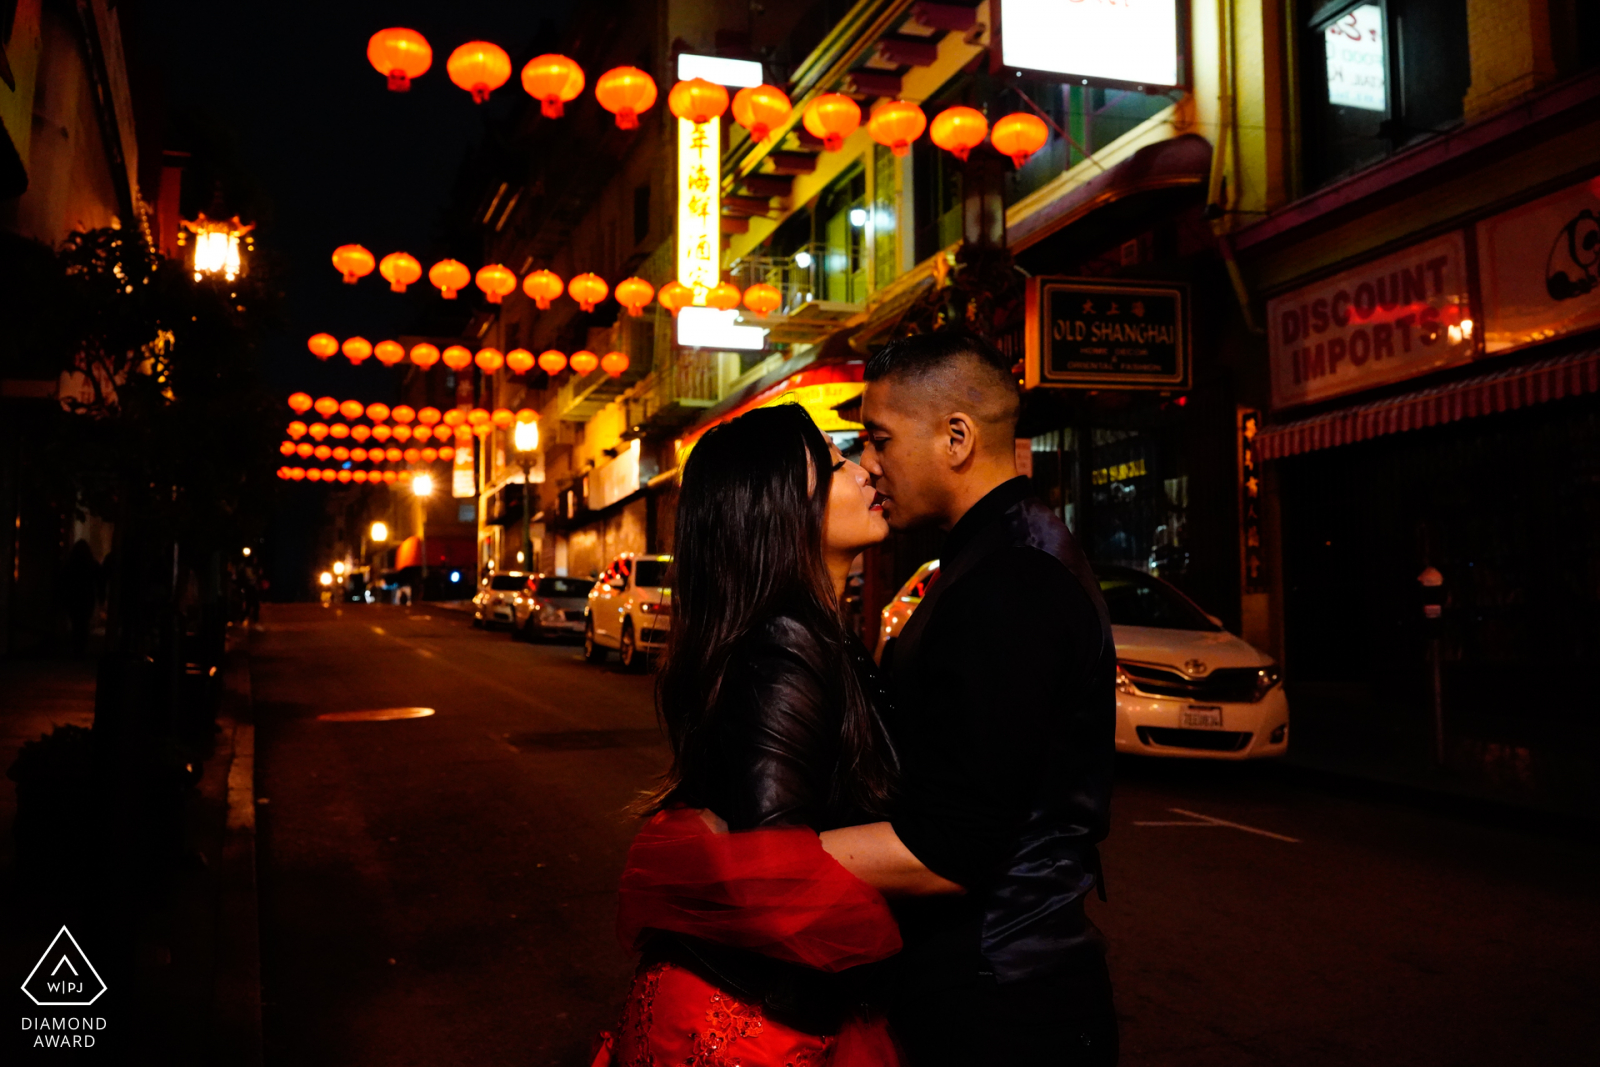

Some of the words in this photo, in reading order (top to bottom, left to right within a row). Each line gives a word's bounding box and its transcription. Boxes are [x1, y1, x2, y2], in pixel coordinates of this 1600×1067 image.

[1053, 319, 1086, 341] OLD
[1091, 321, 1174, 344] SHANGHAI
[1281, 255, 1448, 345] DISCOUNT
[1292, 306, 1440, 385] IMPORTS
